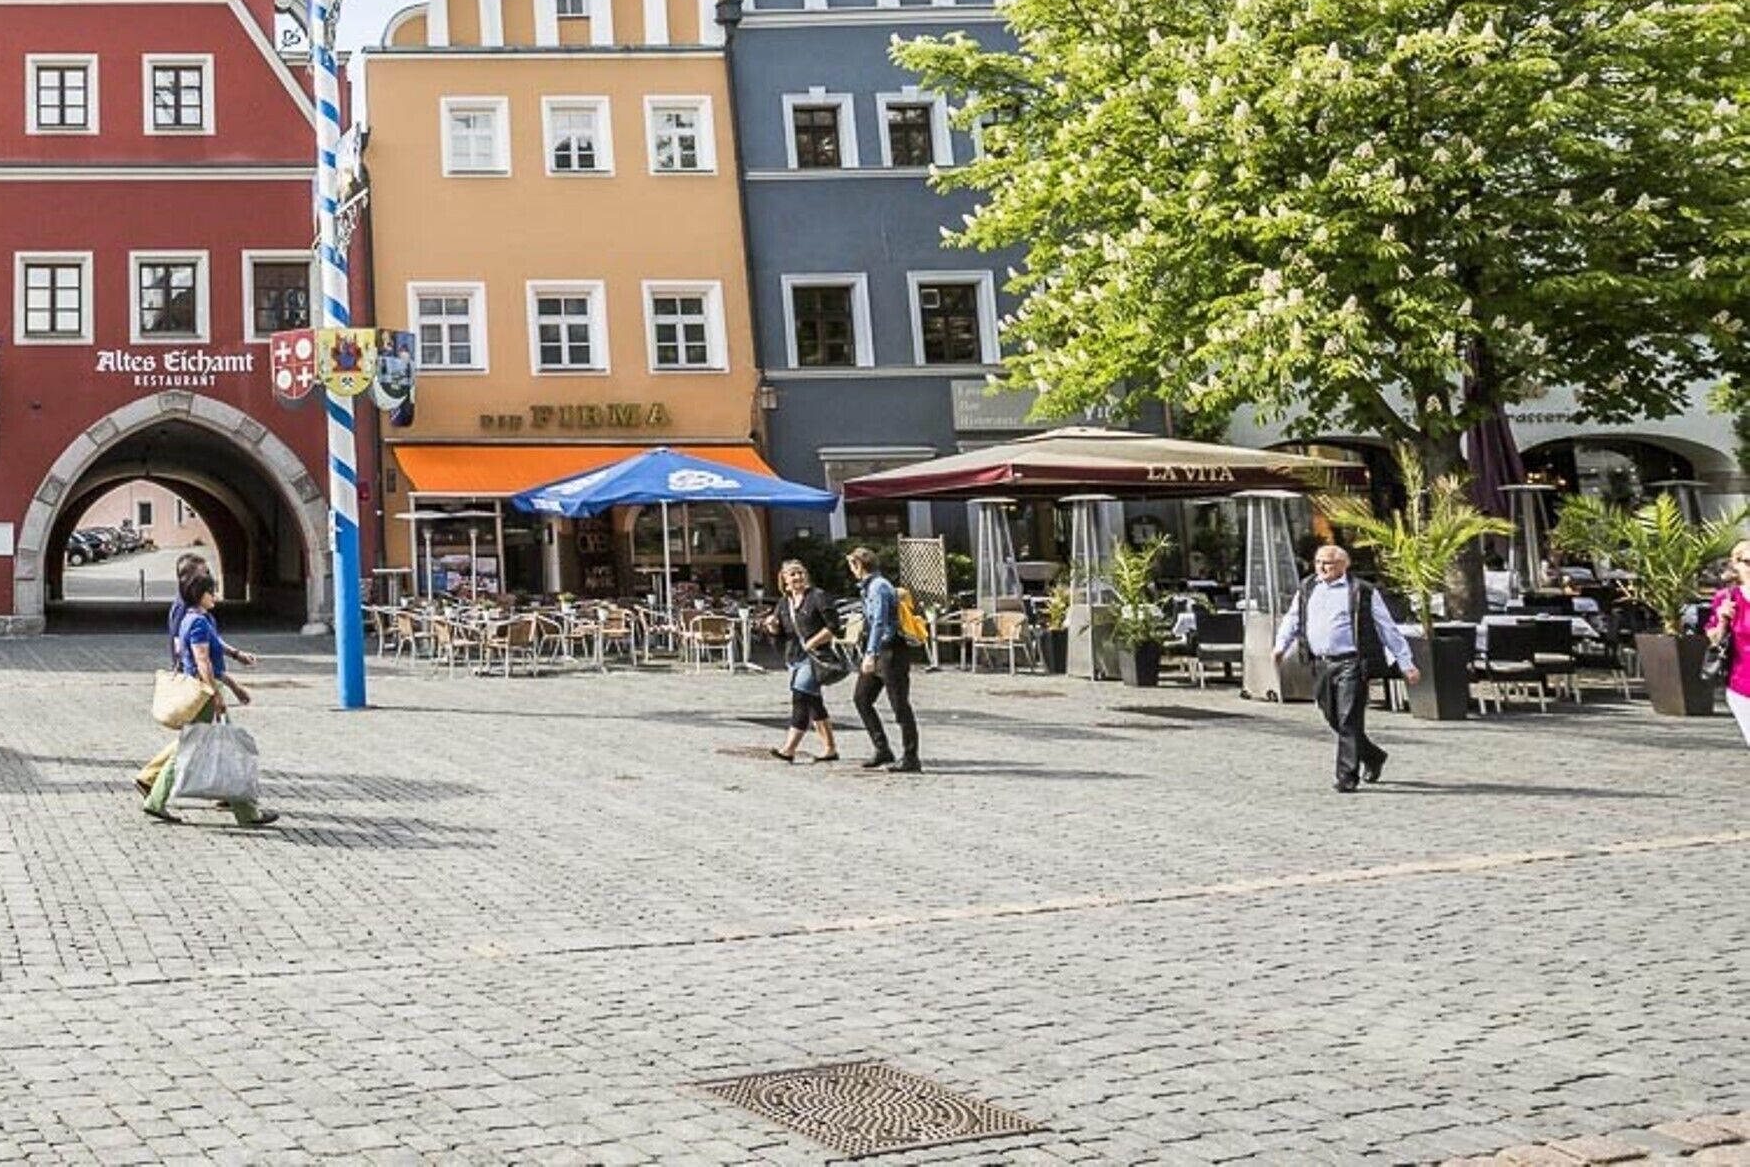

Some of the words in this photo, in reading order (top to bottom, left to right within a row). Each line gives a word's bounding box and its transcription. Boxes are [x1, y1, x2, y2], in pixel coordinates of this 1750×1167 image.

[95, 349, 157, 372] Altes
[163, 349, 255, 375] Eichamt
[134, 375, 216, 386] RESTAURANT
[529, 402, 674, 429] FIRMA
[1146, 466, 1178, 481] LA
[1181, 466, 1235, 481] VITA
